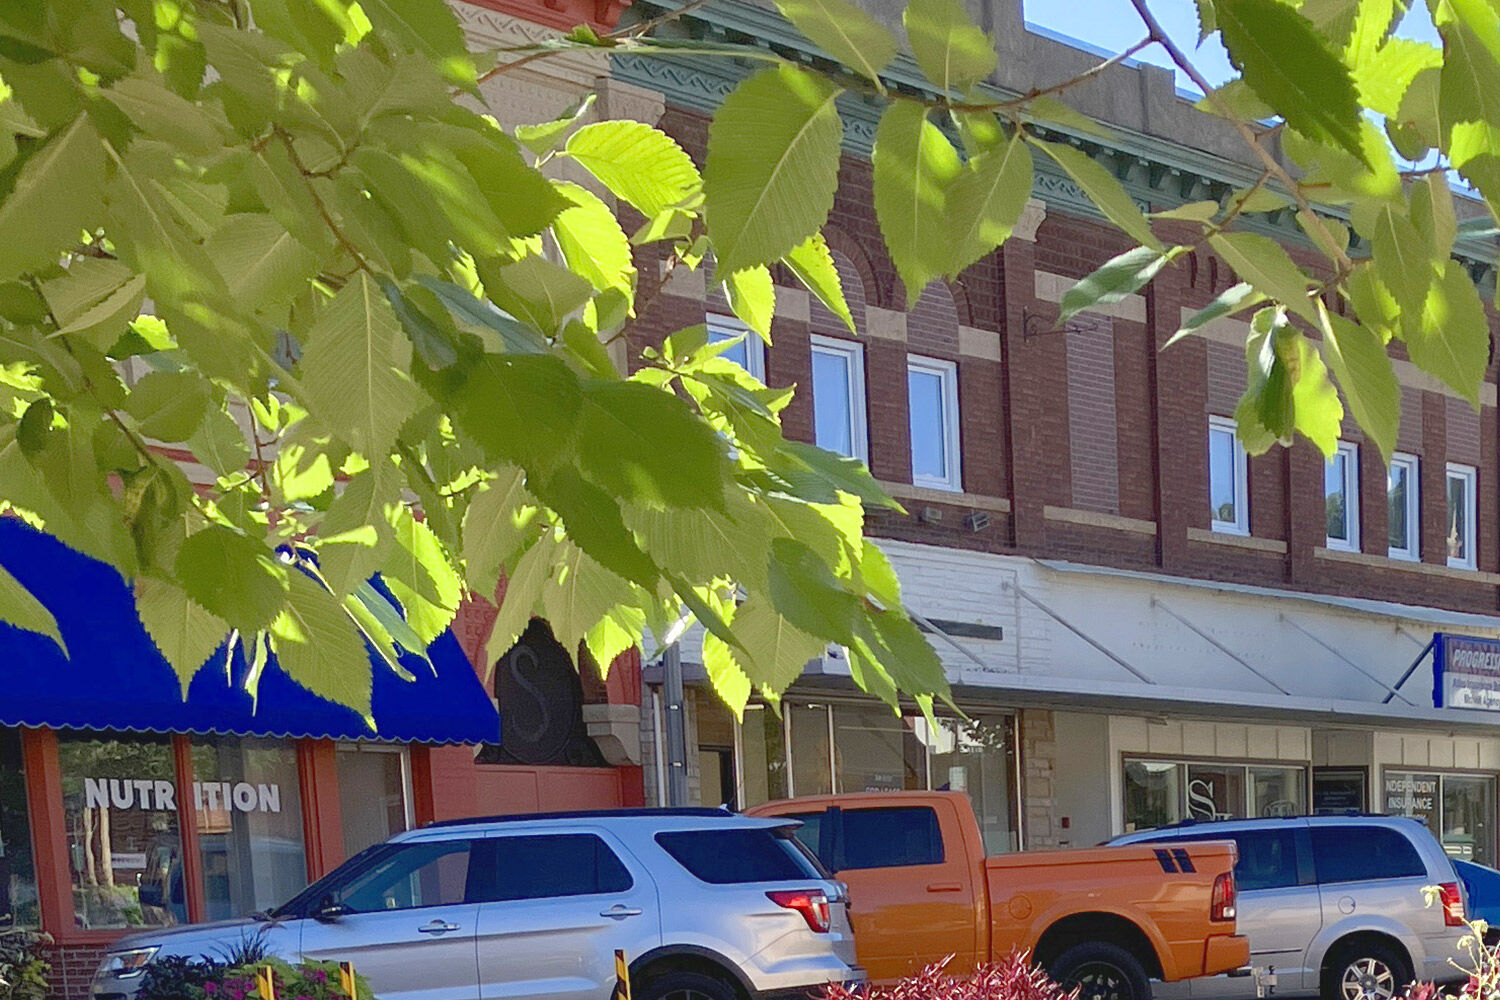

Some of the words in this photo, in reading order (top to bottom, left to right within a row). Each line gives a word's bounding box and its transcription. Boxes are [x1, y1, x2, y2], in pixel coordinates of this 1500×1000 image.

[1385, 780, 1437, 793] NDEPENDENT
[84, 777, 281, 813] NUTRITION
[1388, 796, 1433, 810] INSURANCE
